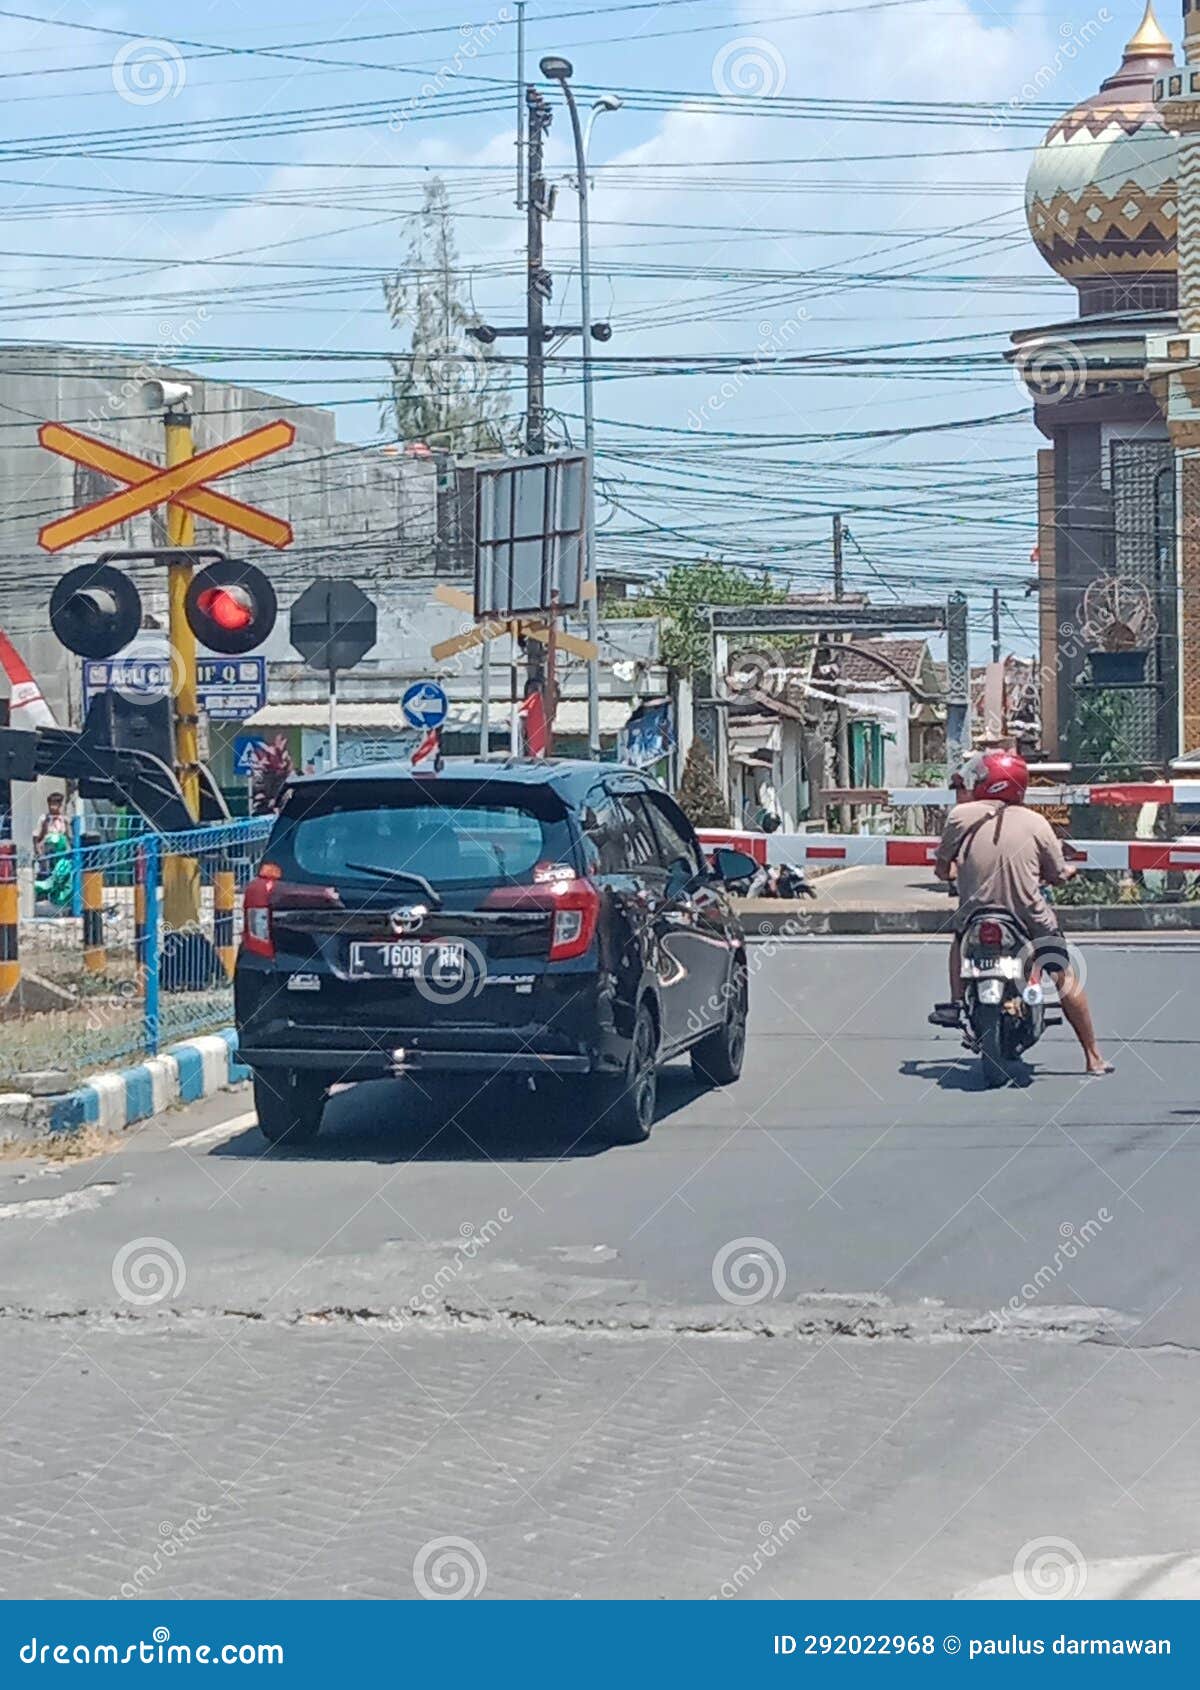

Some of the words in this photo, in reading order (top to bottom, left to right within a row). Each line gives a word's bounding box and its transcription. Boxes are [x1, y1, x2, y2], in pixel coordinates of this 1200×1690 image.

[354, 945, 365, 966] L
[377, 945, 421, 966] 1608
[438, 945, 461, 967] RK
